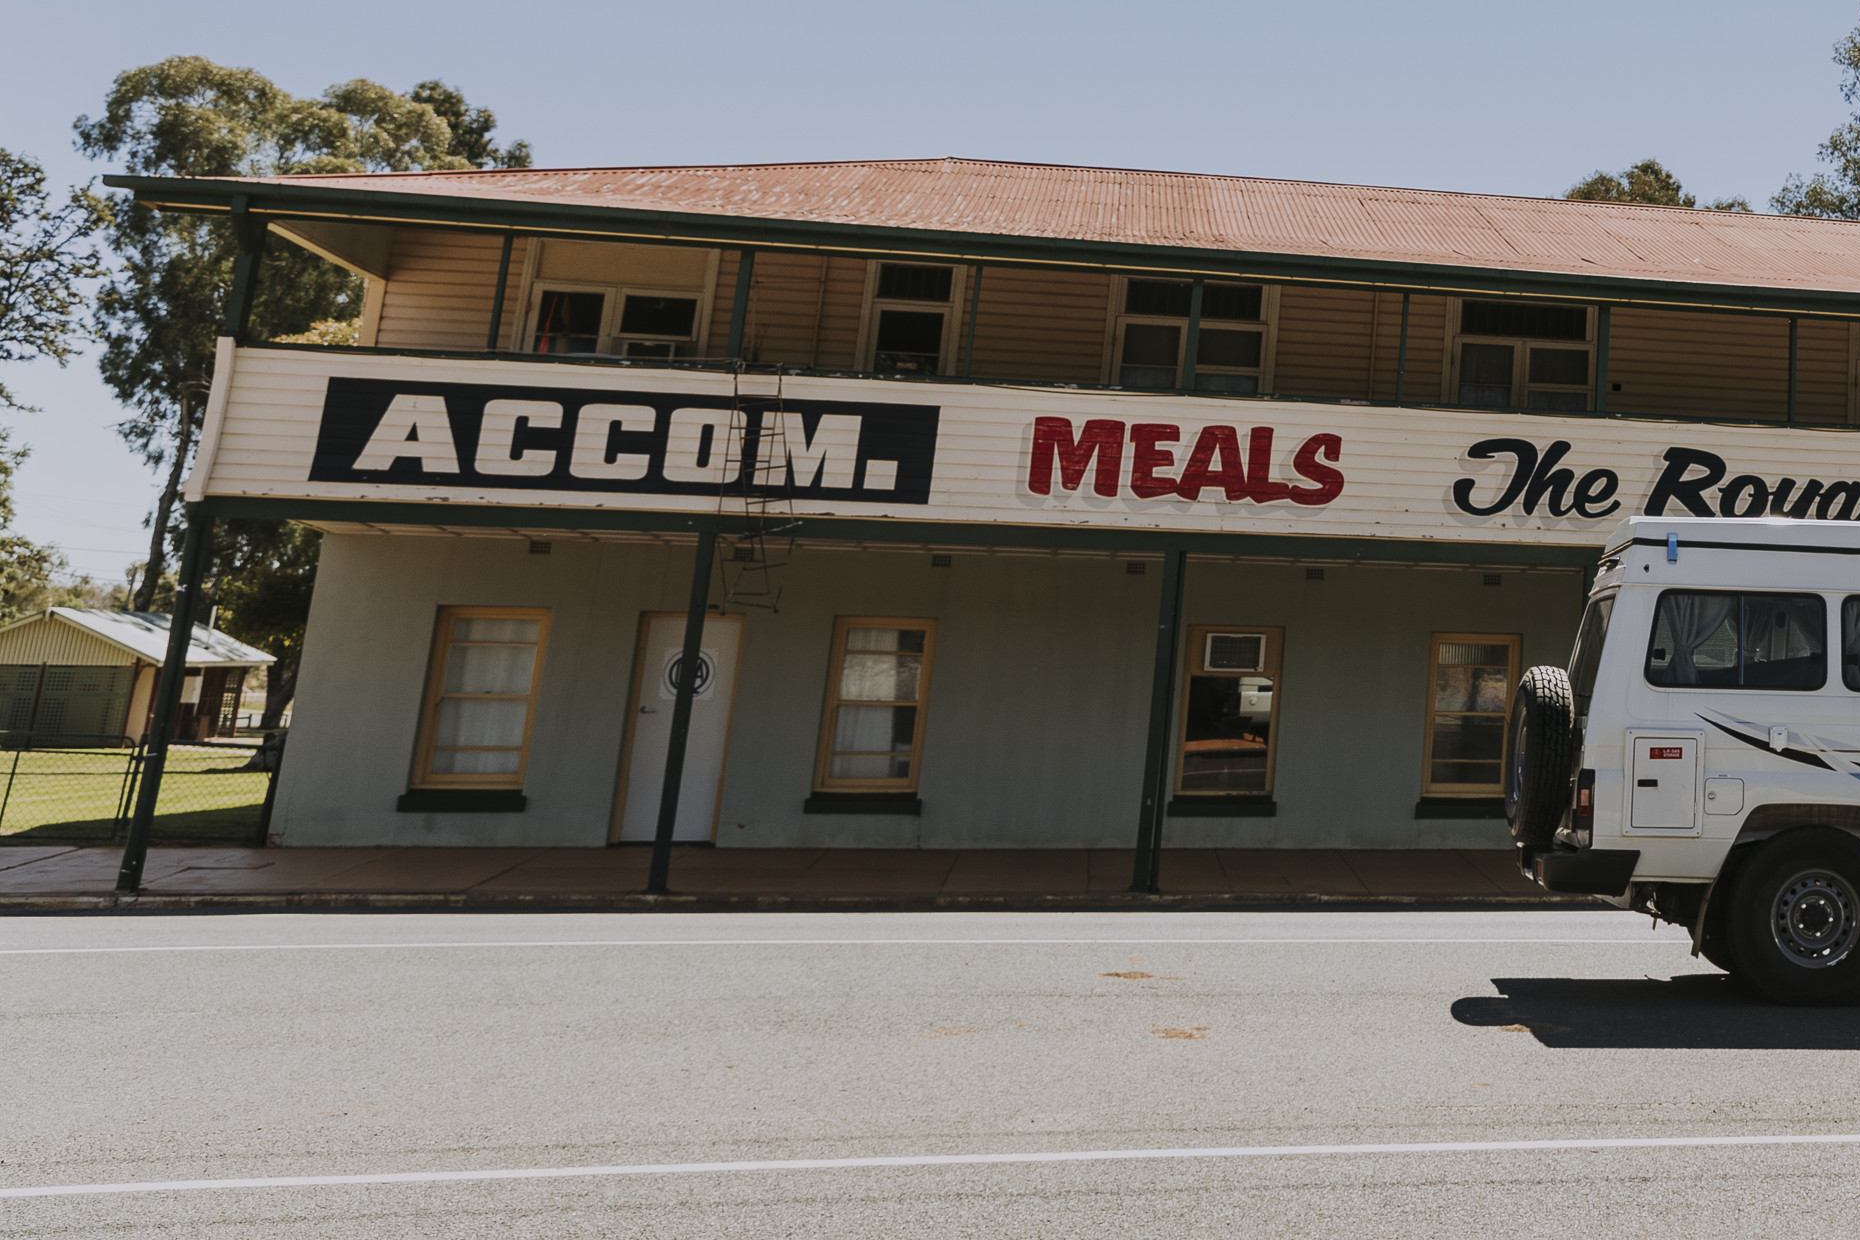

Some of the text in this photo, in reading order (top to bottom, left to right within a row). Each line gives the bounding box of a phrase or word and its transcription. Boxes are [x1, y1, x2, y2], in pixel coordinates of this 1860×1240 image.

[352, 394, 899, 491] ACCOM.
[1027, 416, 1345, 506] MEALS
[1453, 438, 1620, 520] The
